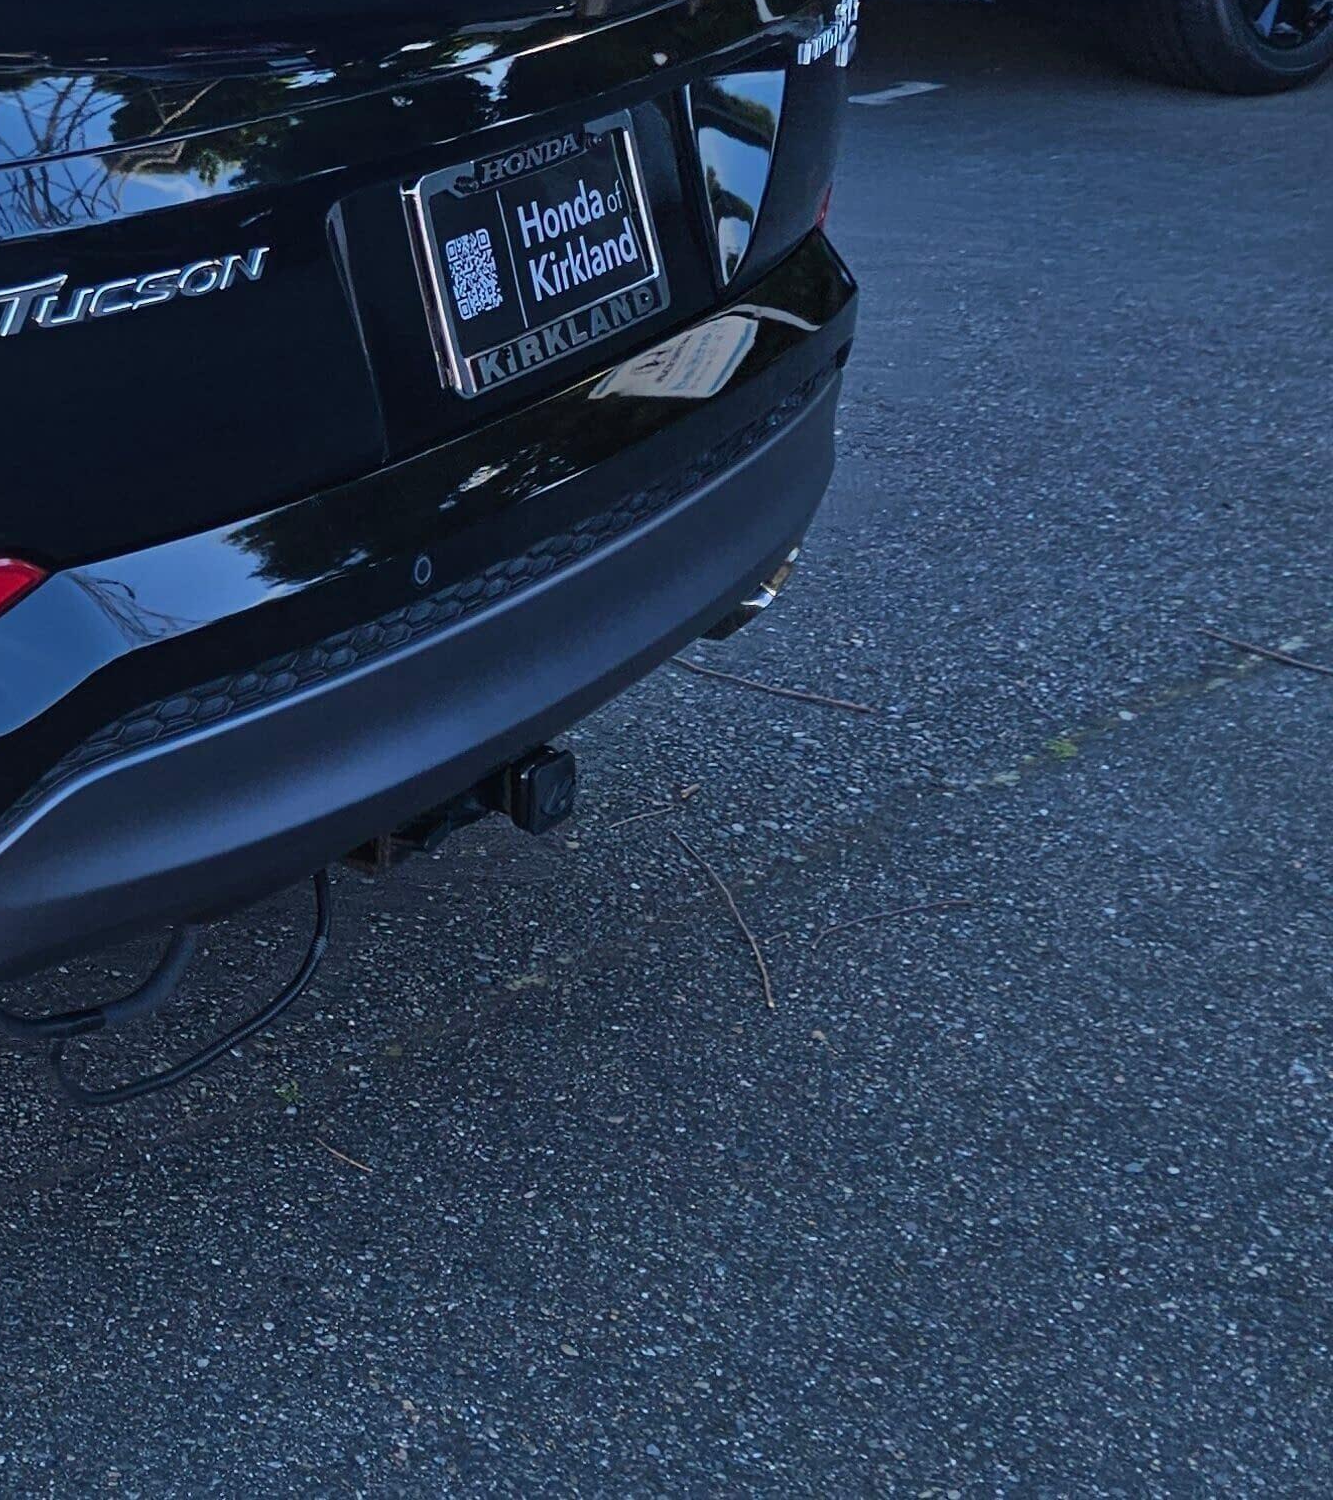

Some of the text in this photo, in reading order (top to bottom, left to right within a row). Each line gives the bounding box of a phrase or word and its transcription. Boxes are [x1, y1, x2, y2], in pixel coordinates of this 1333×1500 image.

[481, 132, 579, 185] HONDA
[517, 178, 625, 248] Honda of
[529, 216, 639, 301] Kirkland
[476, 286, 654, 385] KIRKLAND
